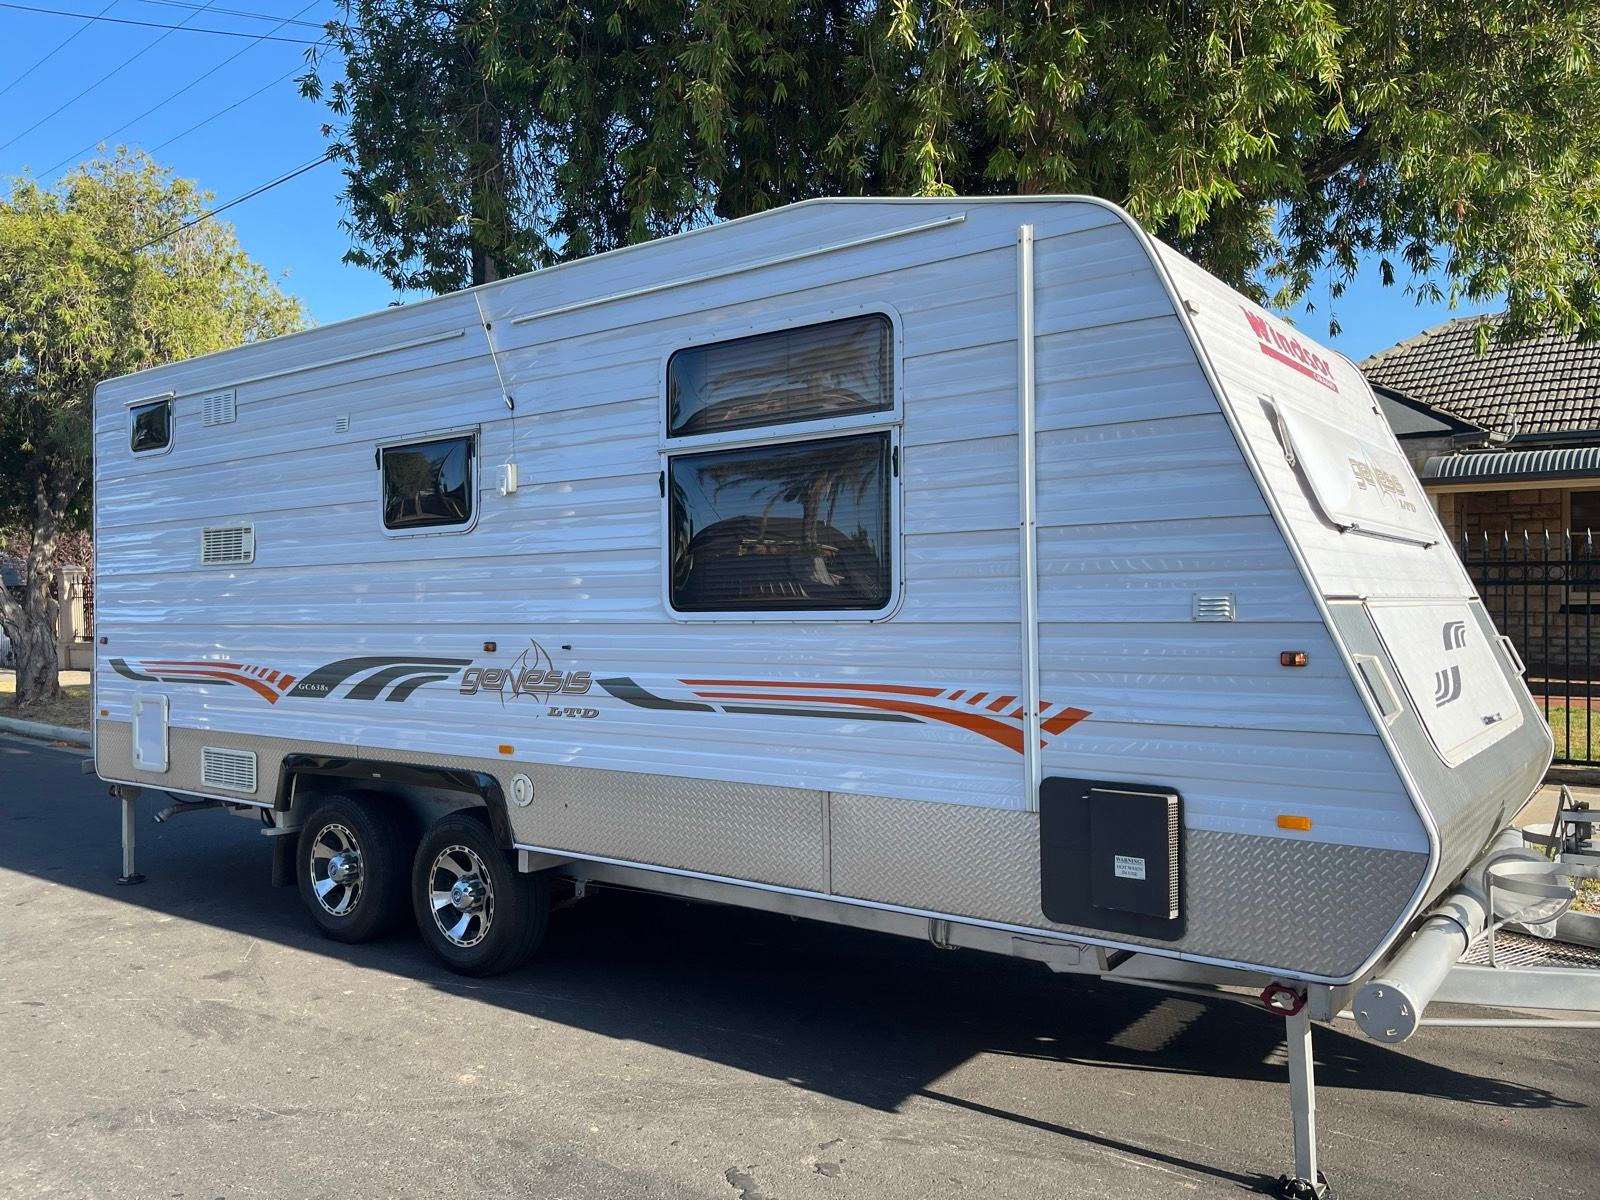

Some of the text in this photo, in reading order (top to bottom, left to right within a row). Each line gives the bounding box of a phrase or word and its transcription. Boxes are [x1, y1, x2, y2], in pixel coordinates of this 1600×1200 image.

[1239, 304, 1335, 381] Windsor
[298, 683, 329, 691] GC638s
[547, 706, 600, 719] LTD
